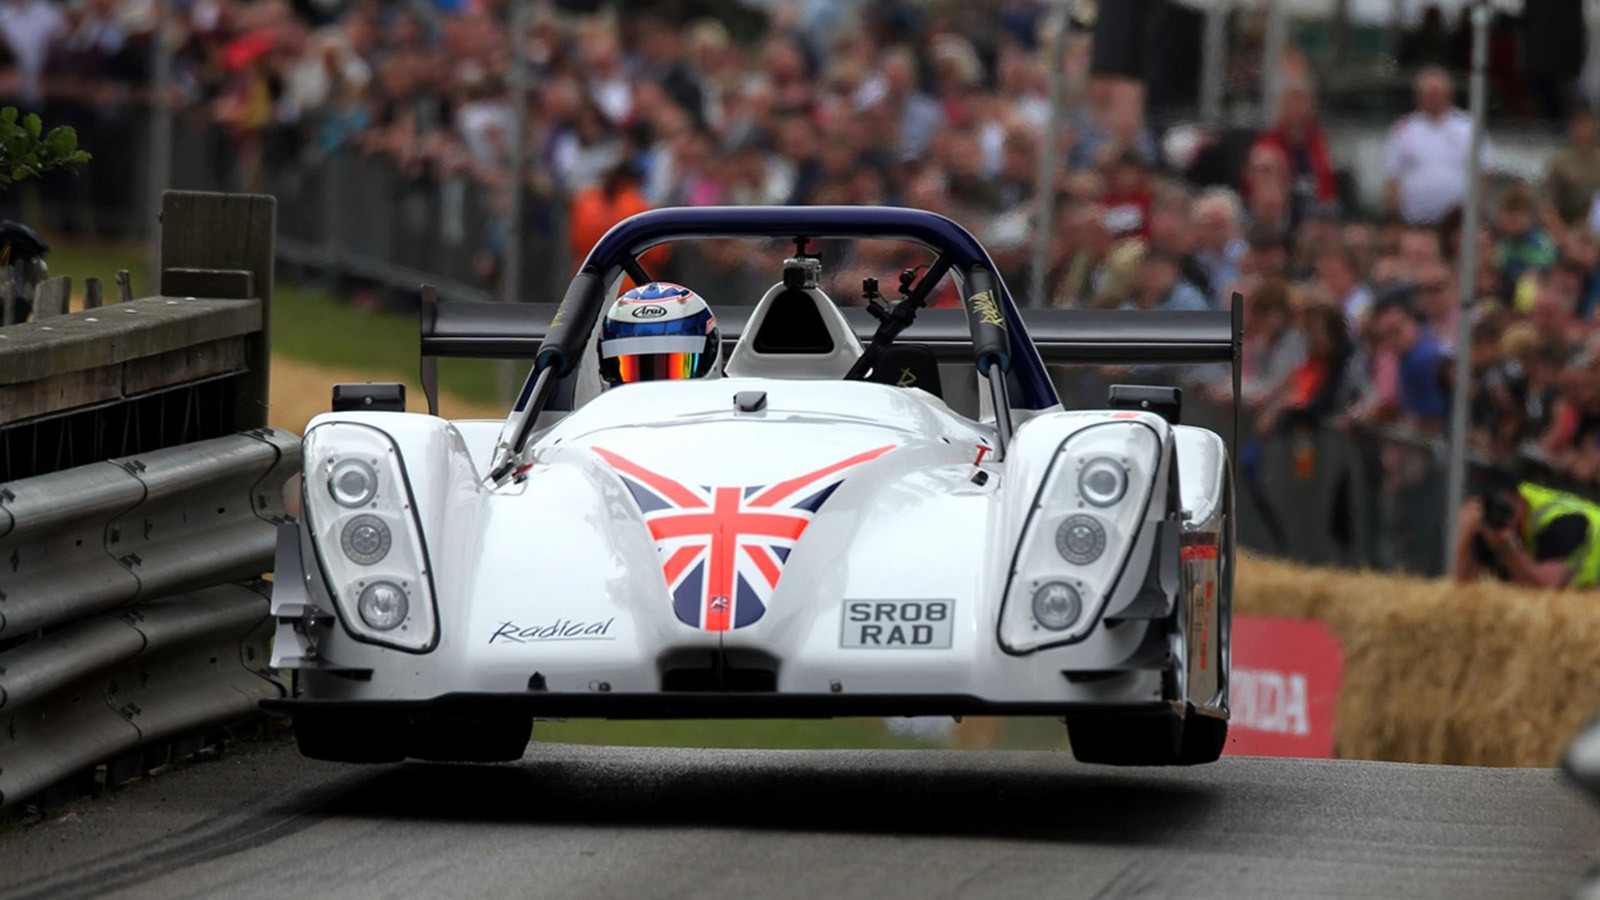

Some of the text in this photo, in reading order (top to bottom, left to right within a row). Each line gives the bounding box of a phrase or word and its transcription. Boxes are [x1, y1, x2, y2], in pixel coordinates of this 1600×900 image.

[633, 305, 664, 316] Arai
[850, 602, 947, 622] SR08
[488, 617, 614, 644] Radical
[860, 625, 933, 645] RAD
[1230, 669, 1310, 735] NDA
